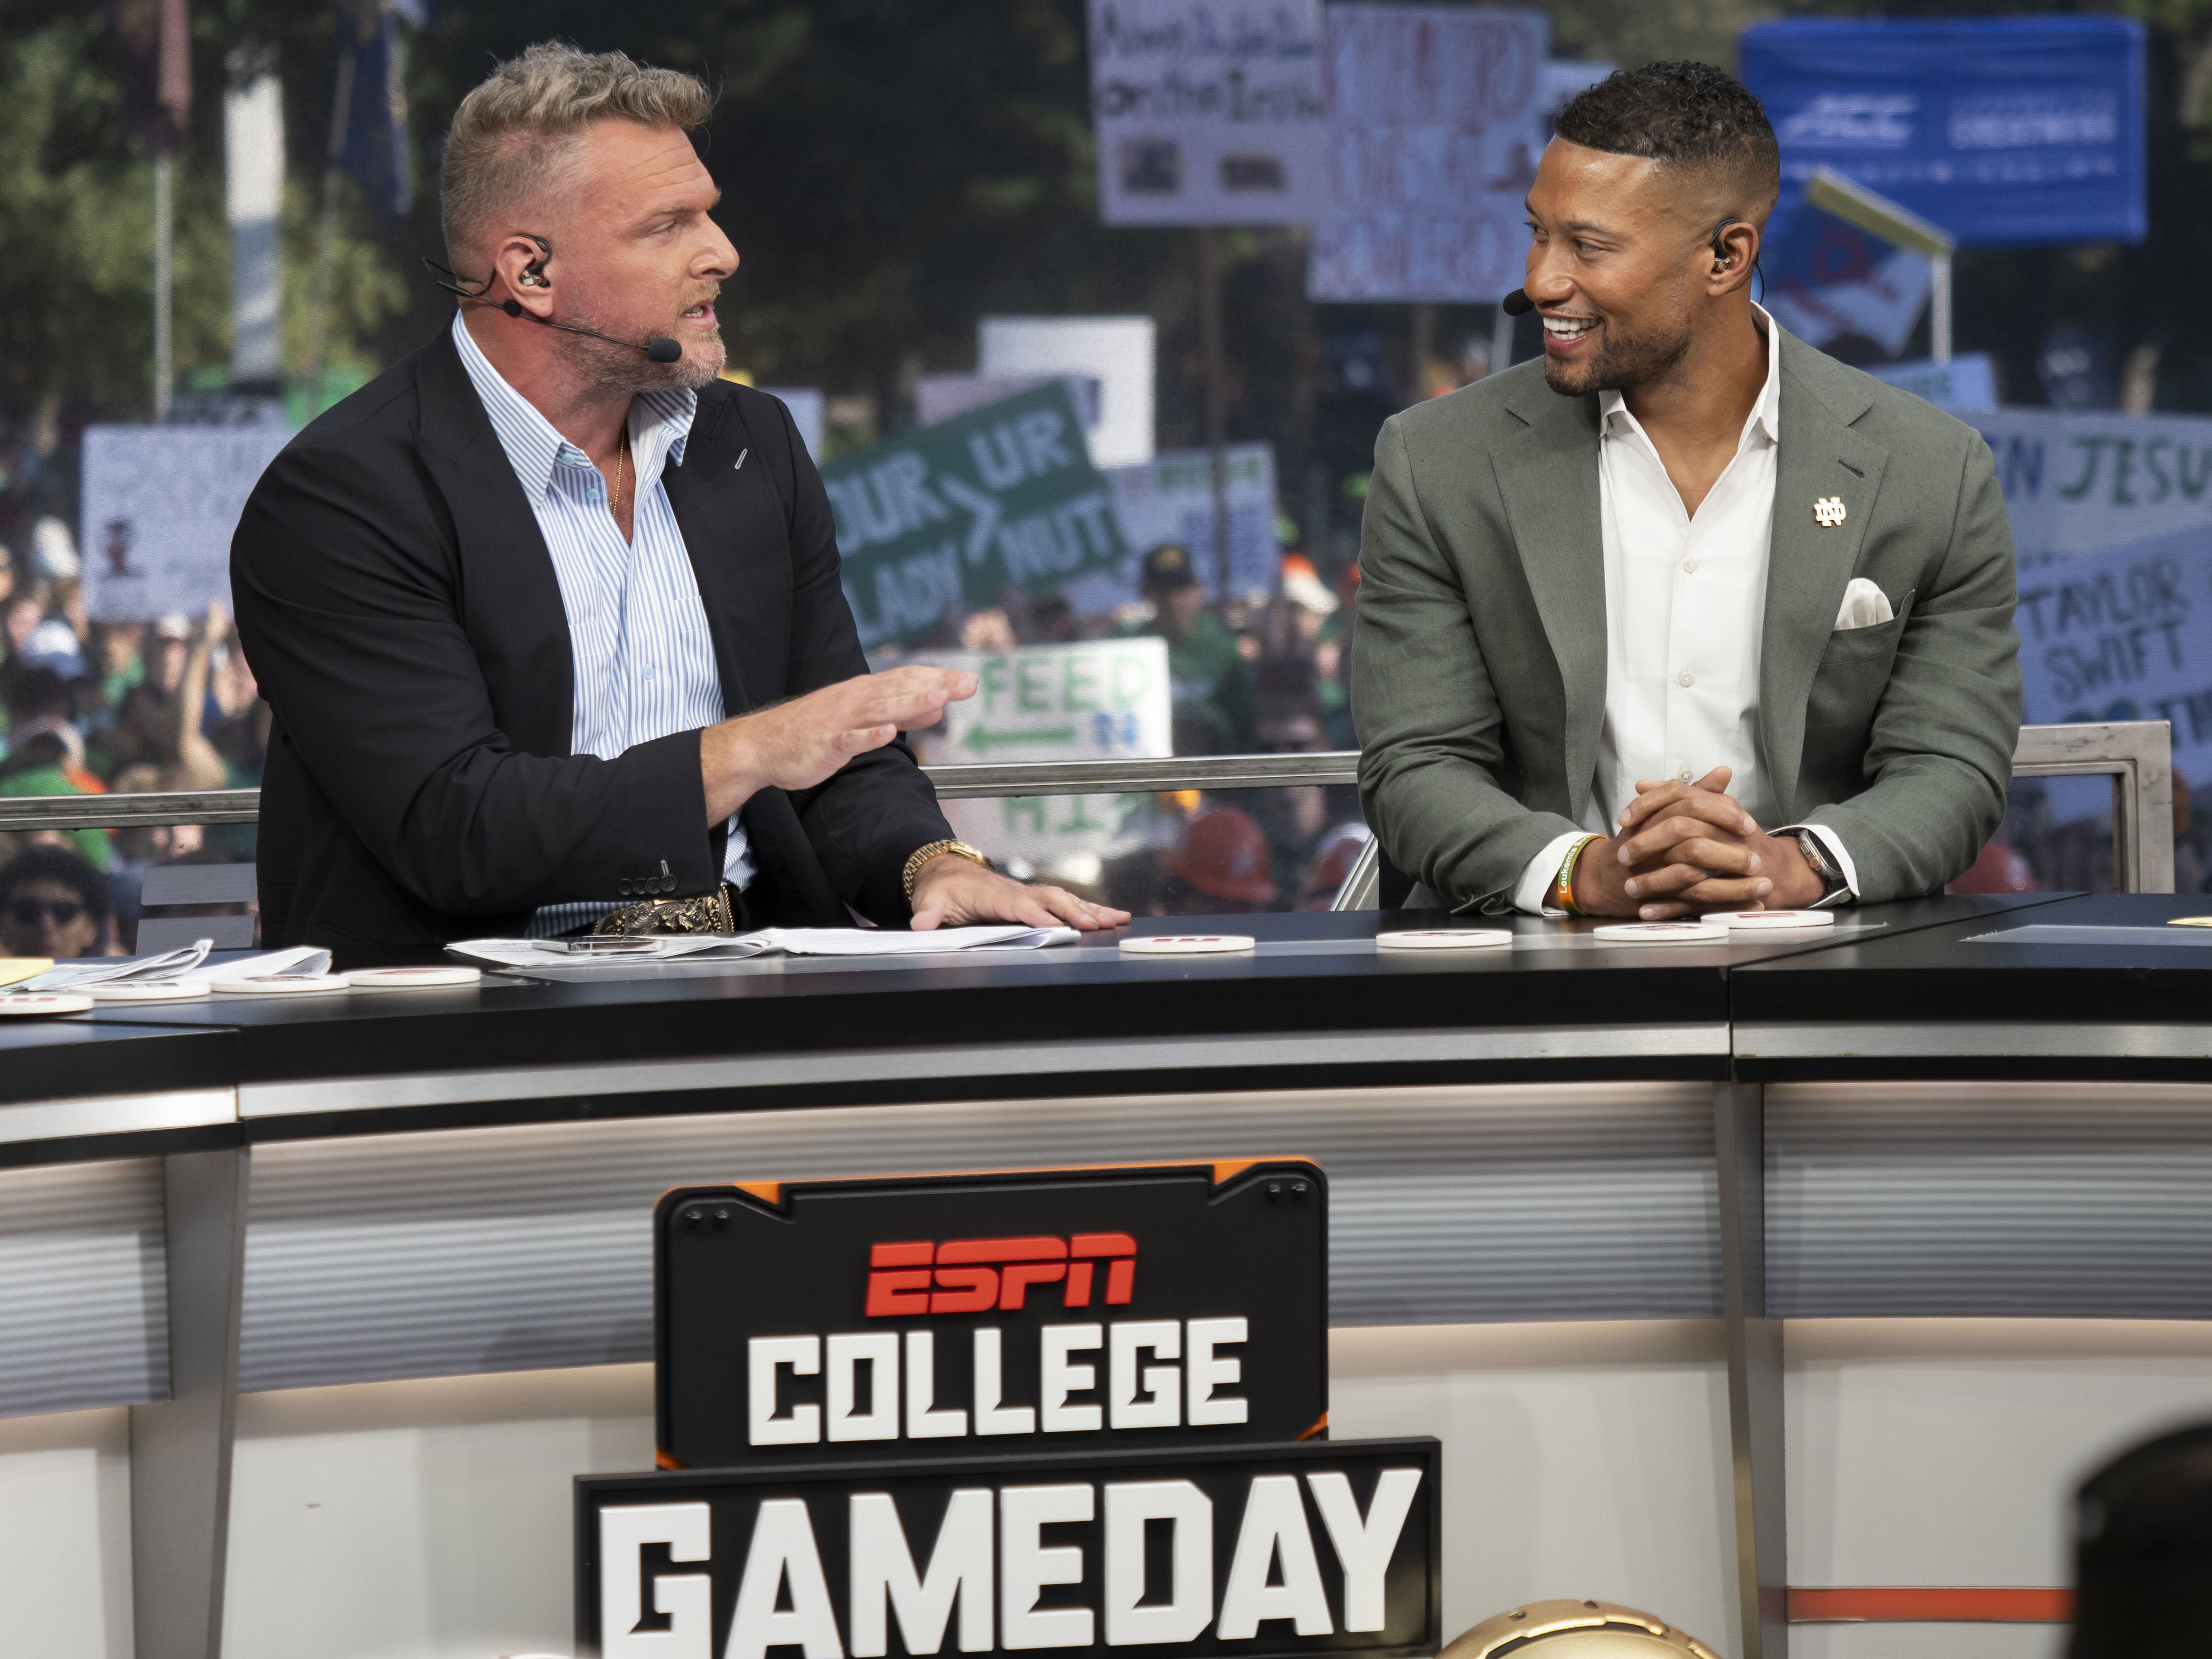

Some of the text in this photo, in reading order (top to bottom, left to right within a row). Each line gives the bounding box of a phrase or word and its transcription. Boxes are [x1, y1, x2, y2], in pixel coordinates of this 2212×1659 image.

[968, 408, 1074, 491] UR
[2017, 562, 2191, 642] TAYLOR
[979, 650, 1151, 716] FEED
[2041, 613, 2184, 705] SWIFT
[1559, 848, 1578, 894] Leukemia
[864, 1232, 1138, 1318] ESPN
[747, 1316, 1249, 1447] COLLEGE
[598, 1468, 1423, 1659] GAMEDAY
